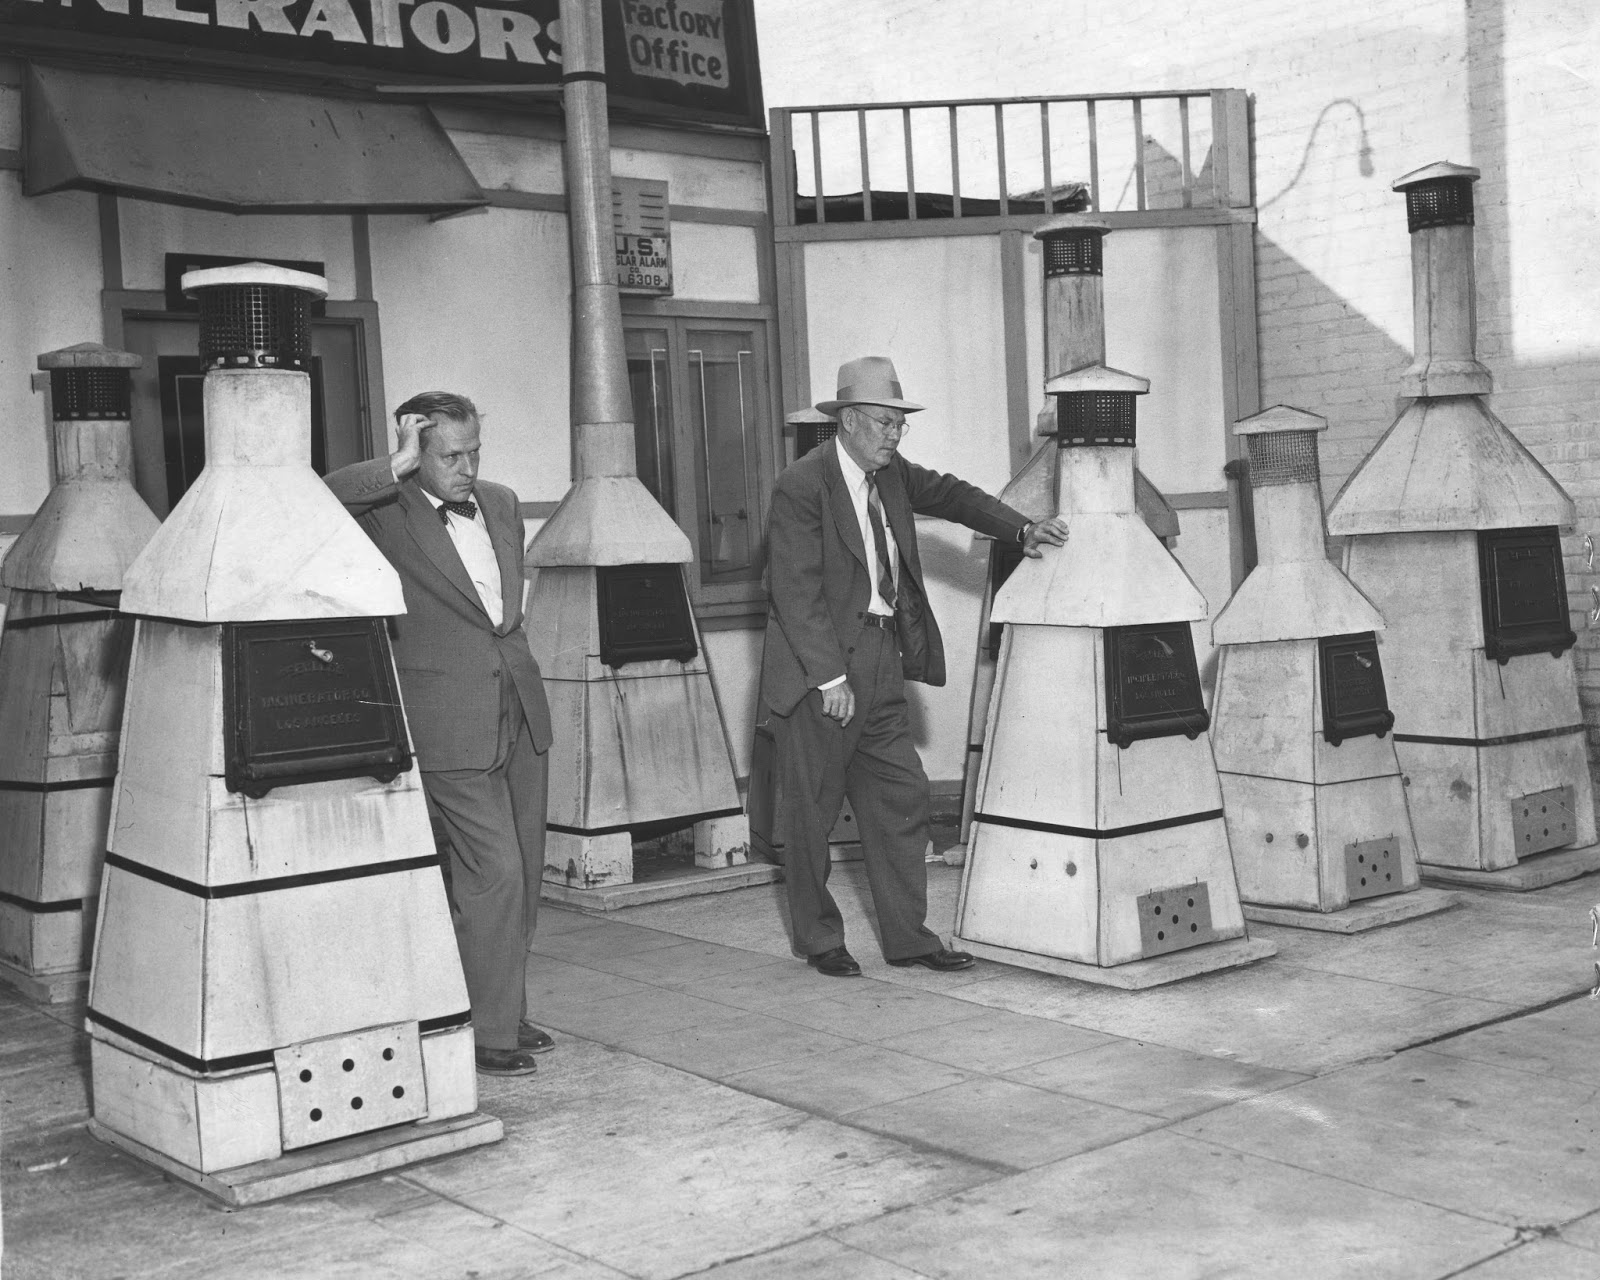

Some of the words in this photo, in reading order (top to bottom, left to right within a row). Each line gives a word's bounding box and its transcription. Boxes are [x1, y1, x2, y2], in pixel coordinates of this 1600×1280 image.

[630, 33, 722, 80] Office
[639, 256, 667, 268] ALARM
[628, 273, 661, 286] 6308
